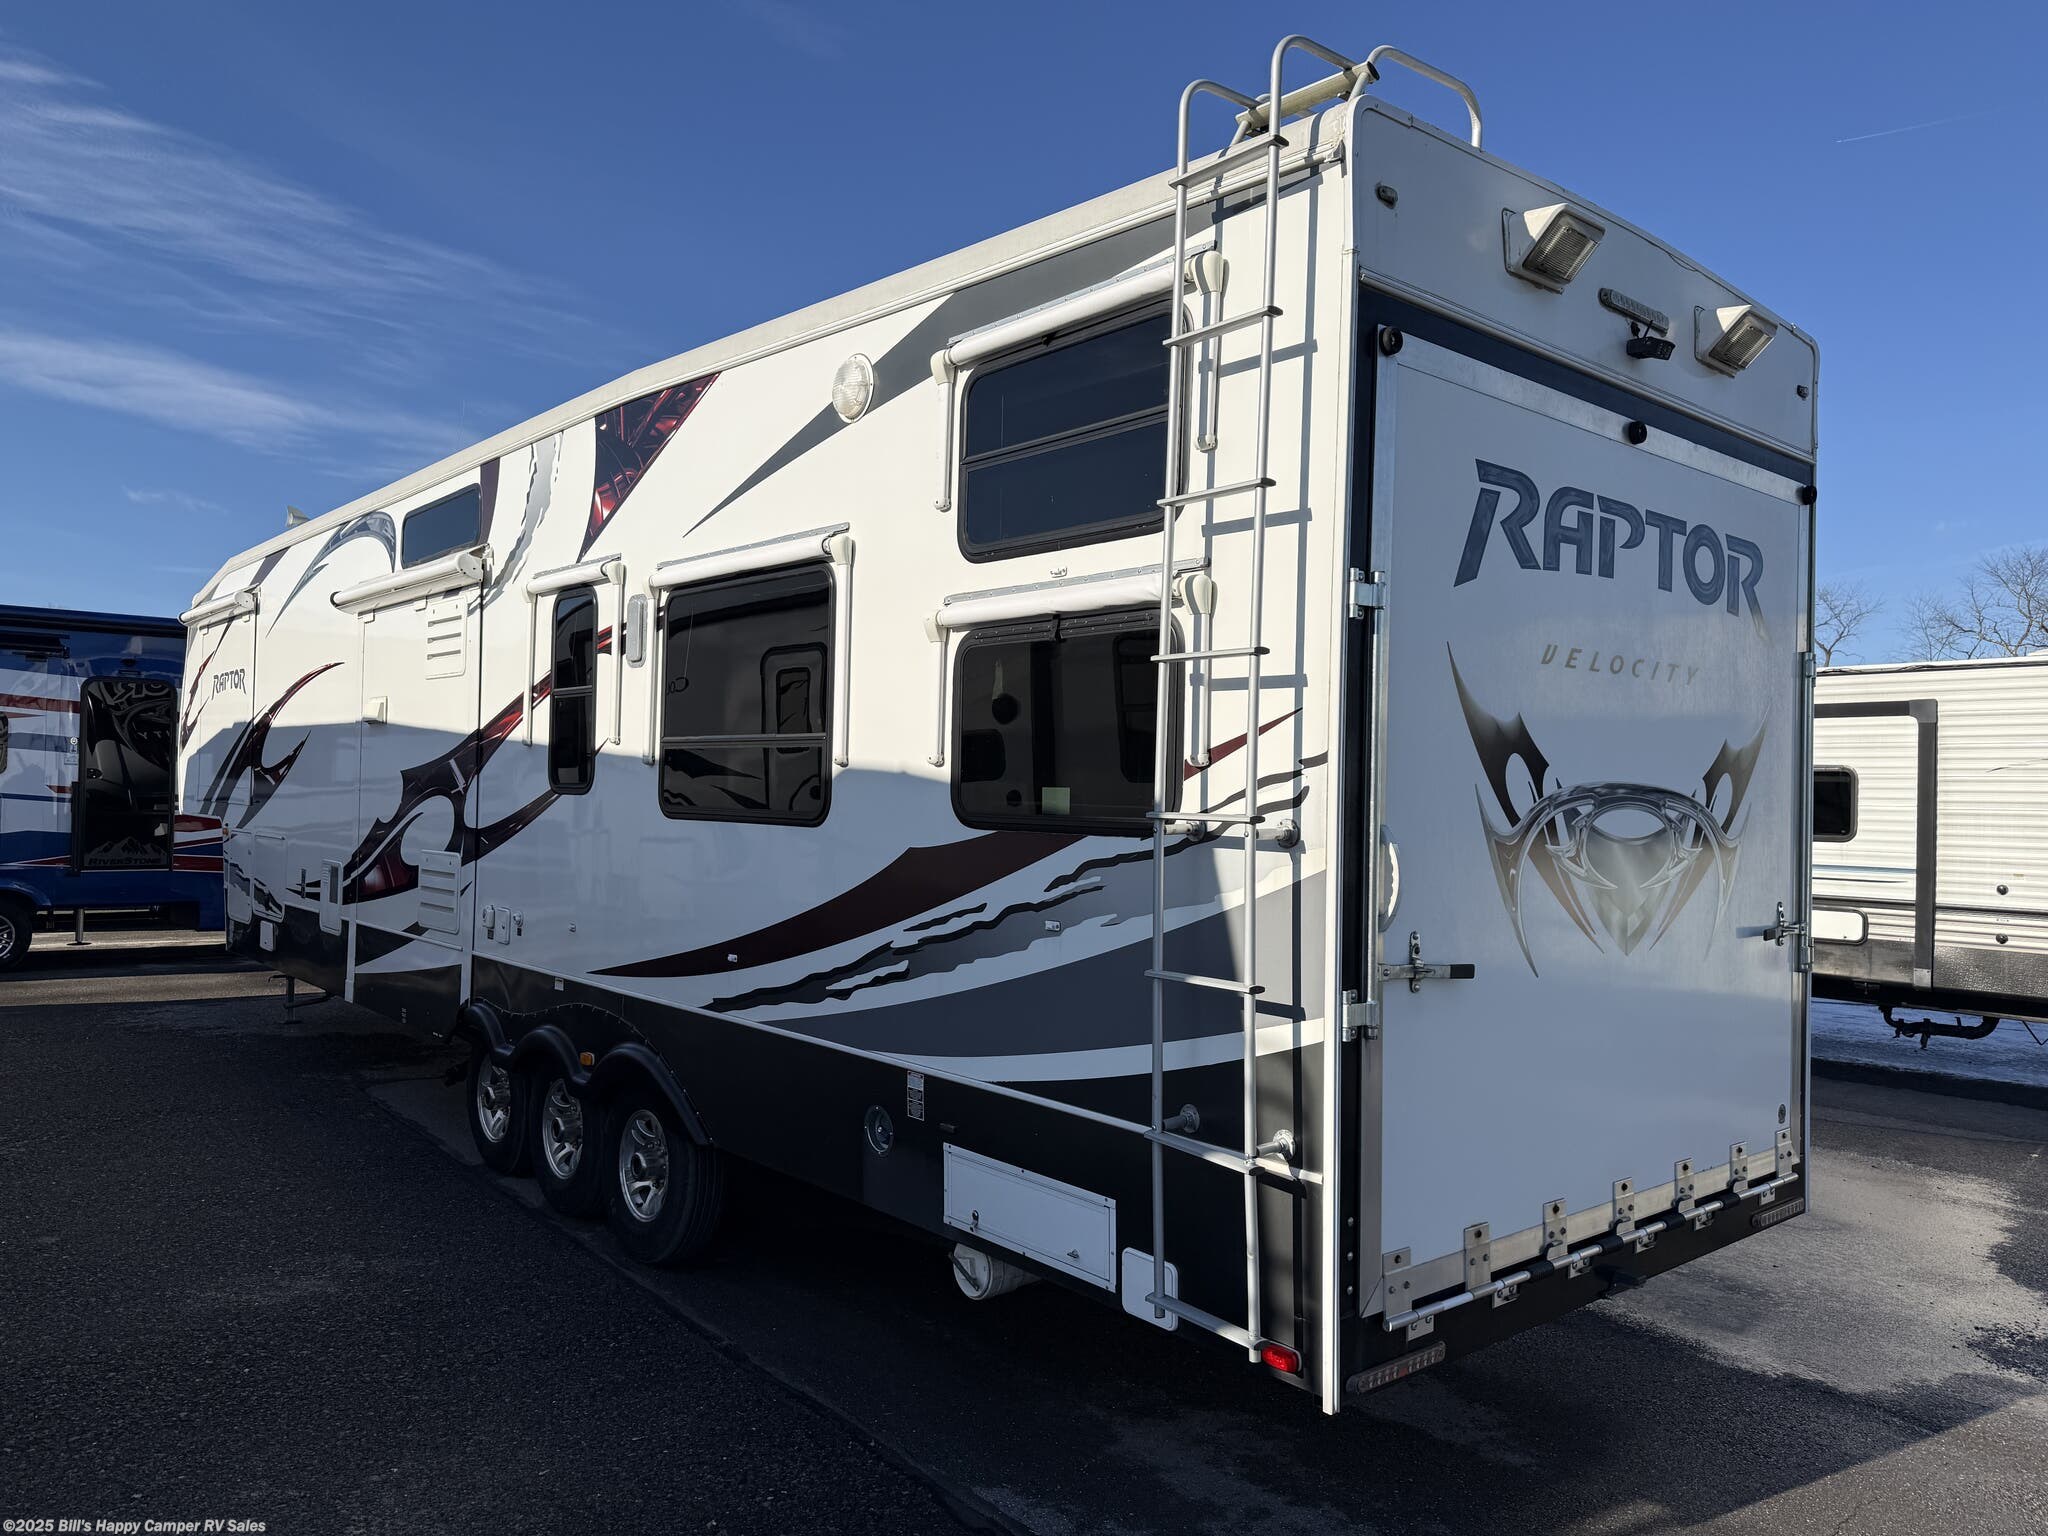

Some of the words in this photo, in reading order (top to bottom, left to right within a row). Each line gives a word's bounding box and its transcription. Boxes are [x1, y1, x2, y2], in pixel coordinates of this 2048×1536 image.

[1453, 458, 1769, 643] RAPTOR
[212, 668, 247, 700] RAPTOR
[1541, 643, 1701, 685] VELOCITY
